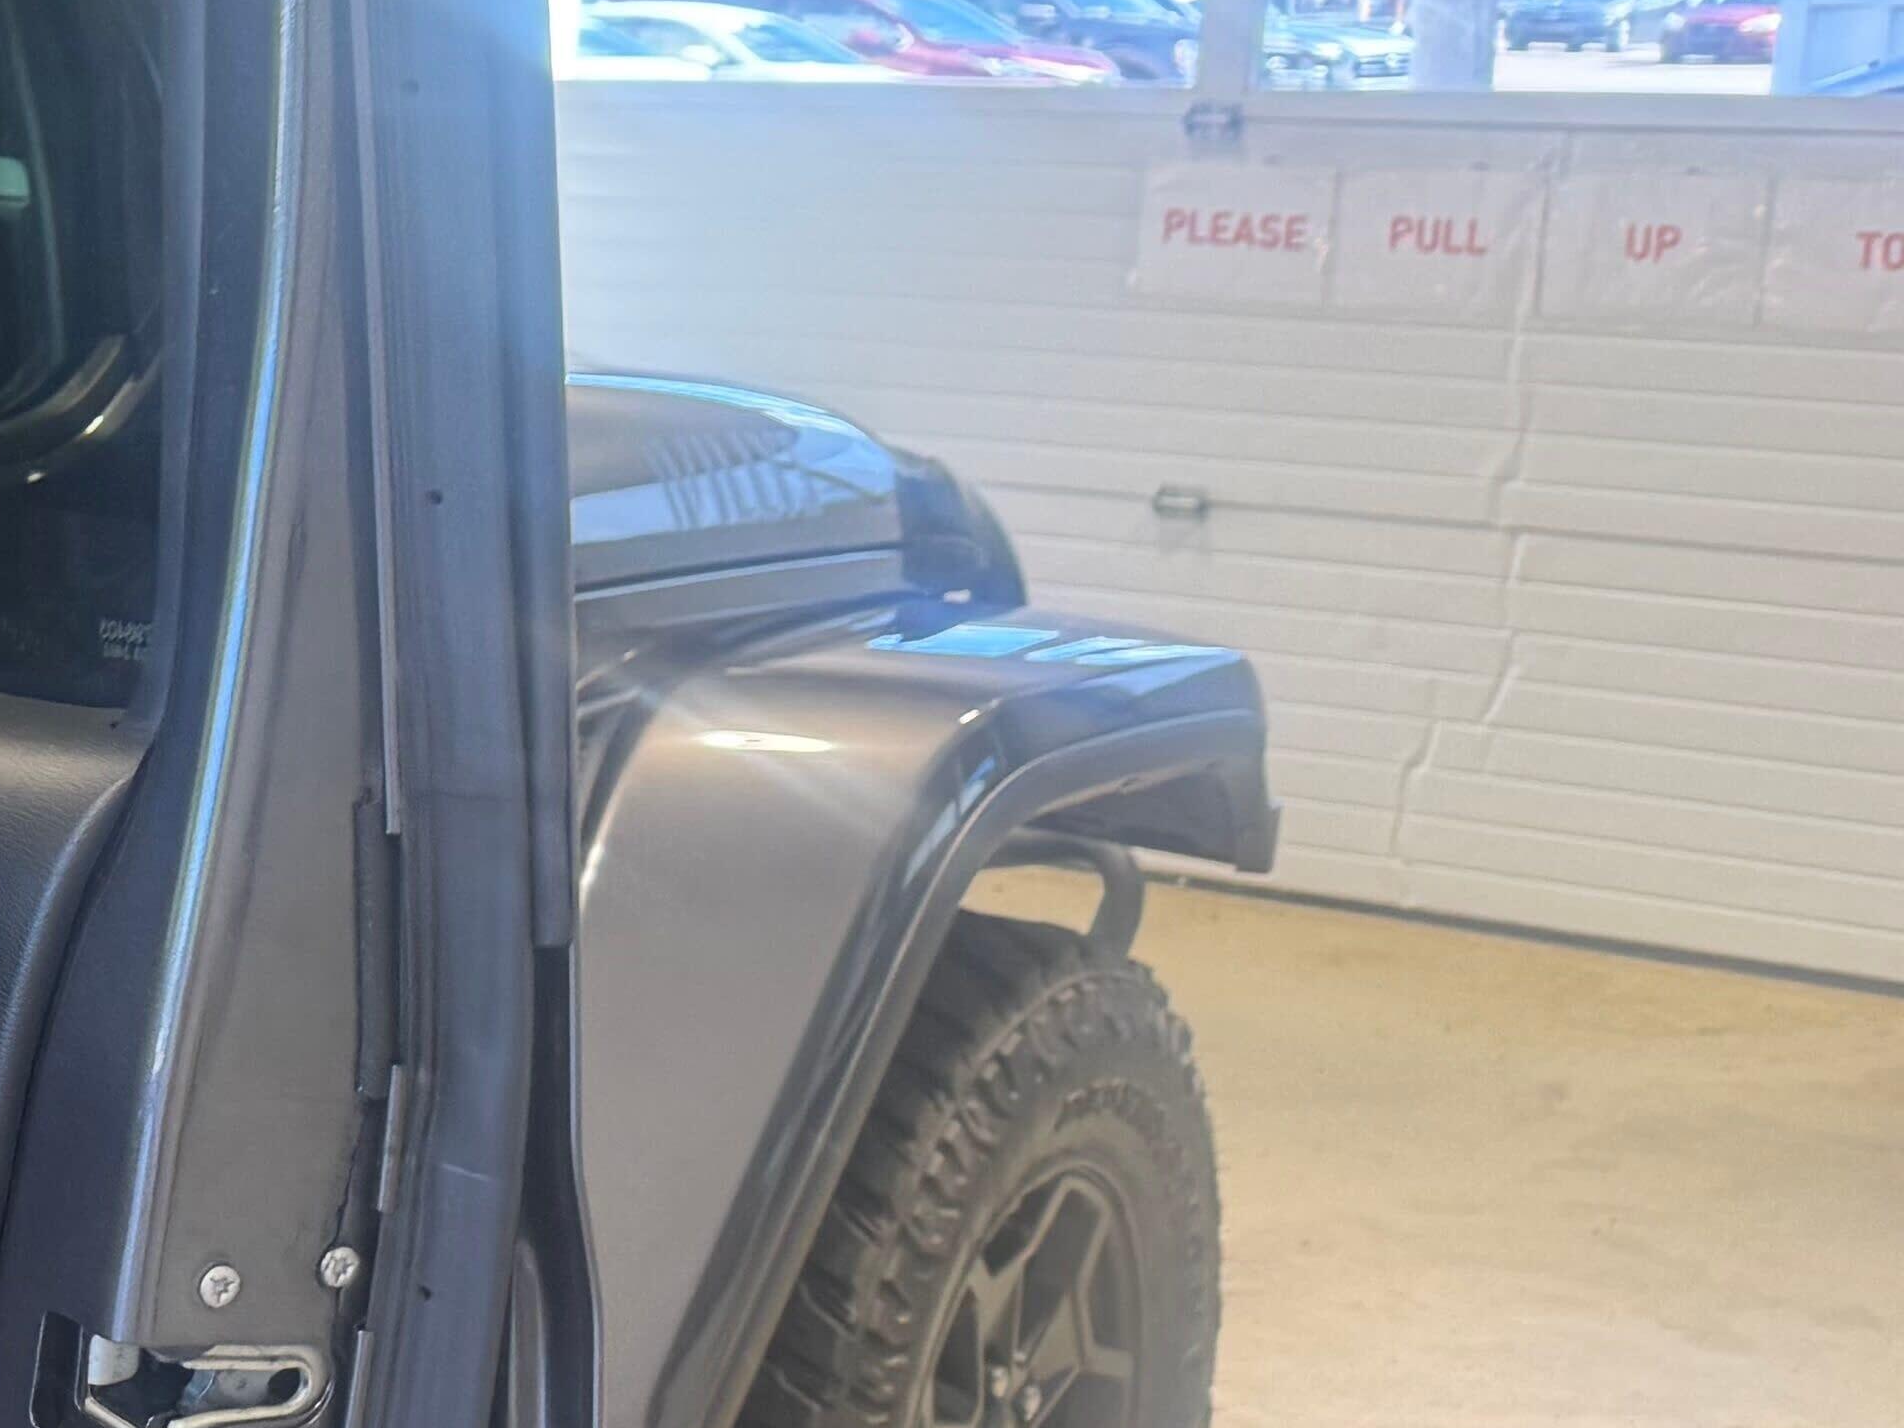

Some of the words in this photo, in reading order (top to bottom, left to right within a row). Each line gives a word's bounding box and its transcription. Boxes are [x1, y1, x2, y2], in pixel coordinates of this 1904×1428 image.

[1161, 207, 1308, 252] PLEASE
[1389, 215, 1489, 256] PULL
[1626, 223, 1682, 261] UP
[1857, 231, 1904, 270] TO
